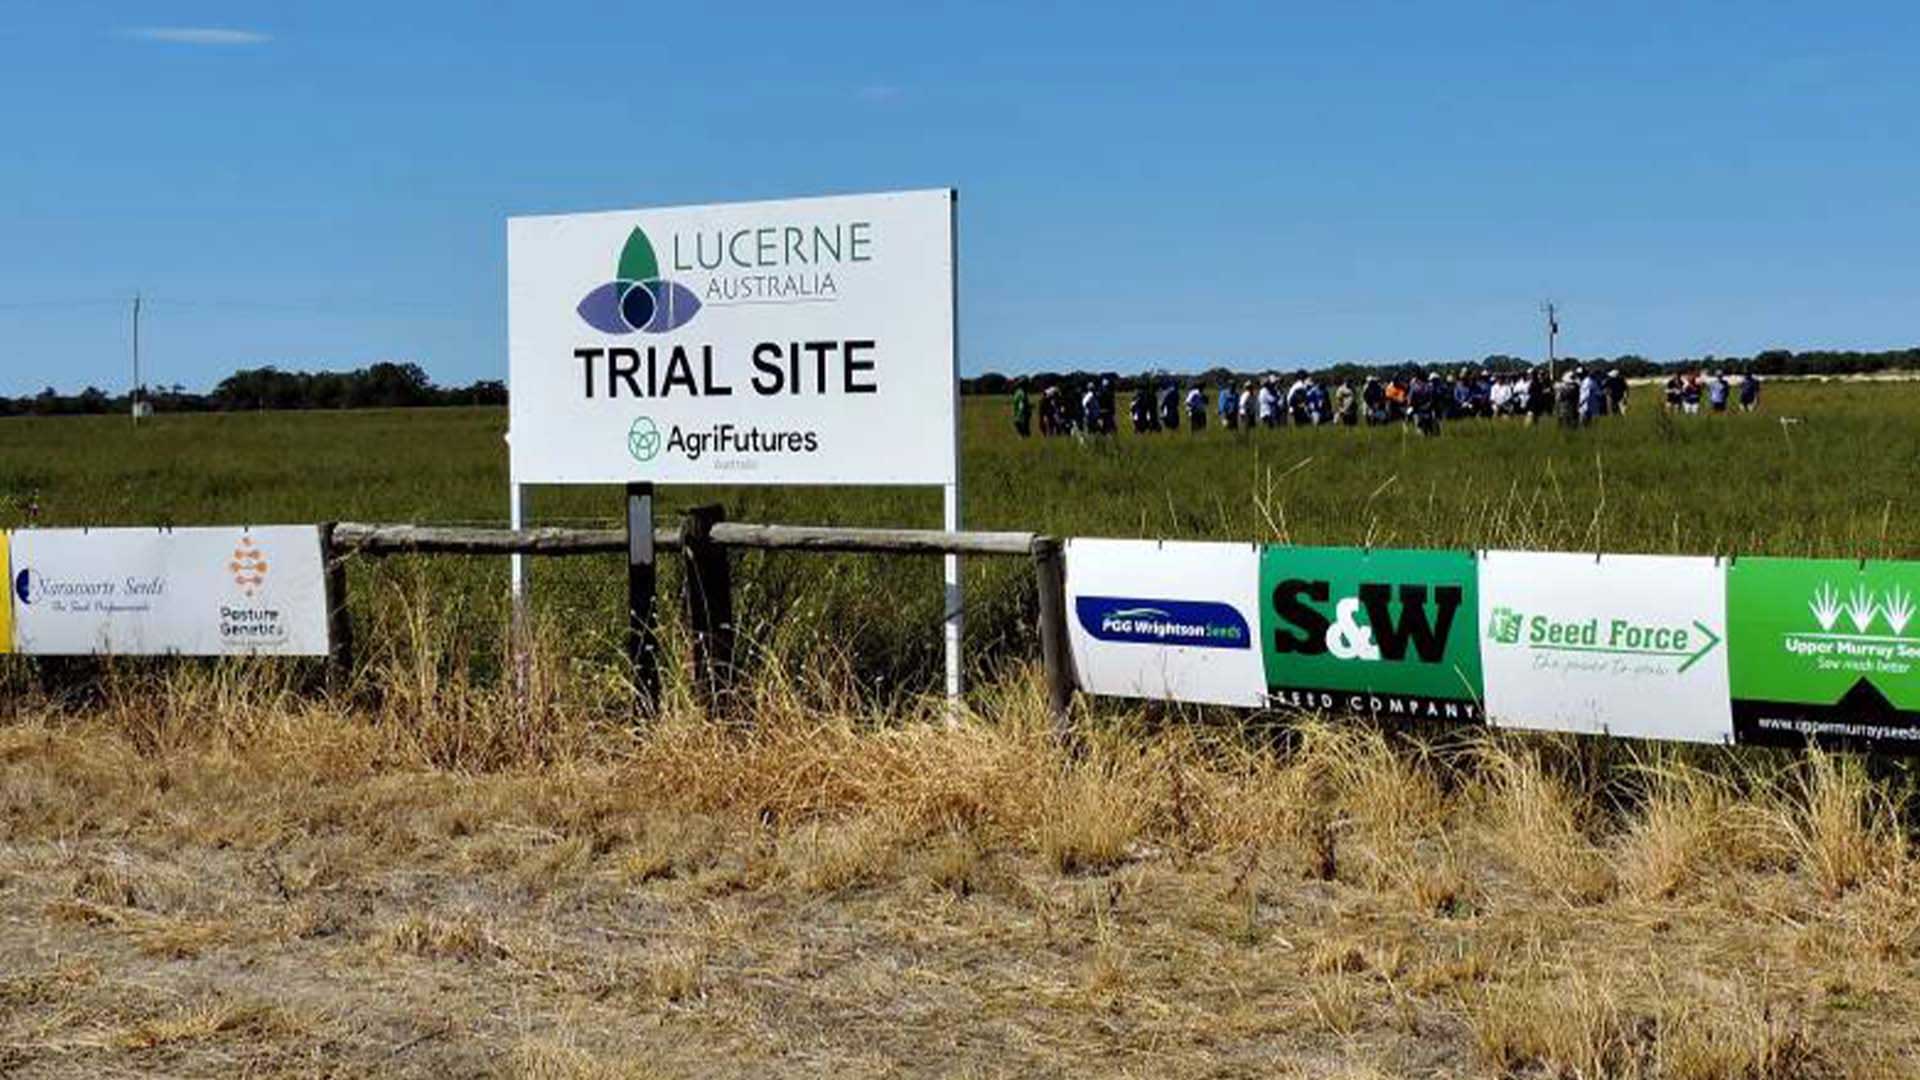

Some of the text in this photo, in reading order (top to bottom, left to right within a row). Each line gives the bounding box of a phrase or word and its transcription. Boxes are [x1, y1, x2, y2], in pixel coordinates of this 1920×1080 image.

[673, 222, 873, 271] LUCERNE
[706, 273, 838, 300] AUSTRALIA
[574, 340, 878, 399] TRIAL SITE
[667, 424, 819, 460] AgriFutures
[220, 607, 279, 621] Pasture
[1273, 578, 1463, 664] S&W
[220, 622, 284, 637] Genetics
[1102, 618, 1132, 633] PGG
[1134, 620, 1205, 639] Wrightson
[1529, 615, 1689, 650] Seed Force
[1785, 638, 1834, 656] Upper
[1837, 642, 1894, 660] Murray
[1351, 696, 1474, 719] COMPANY
